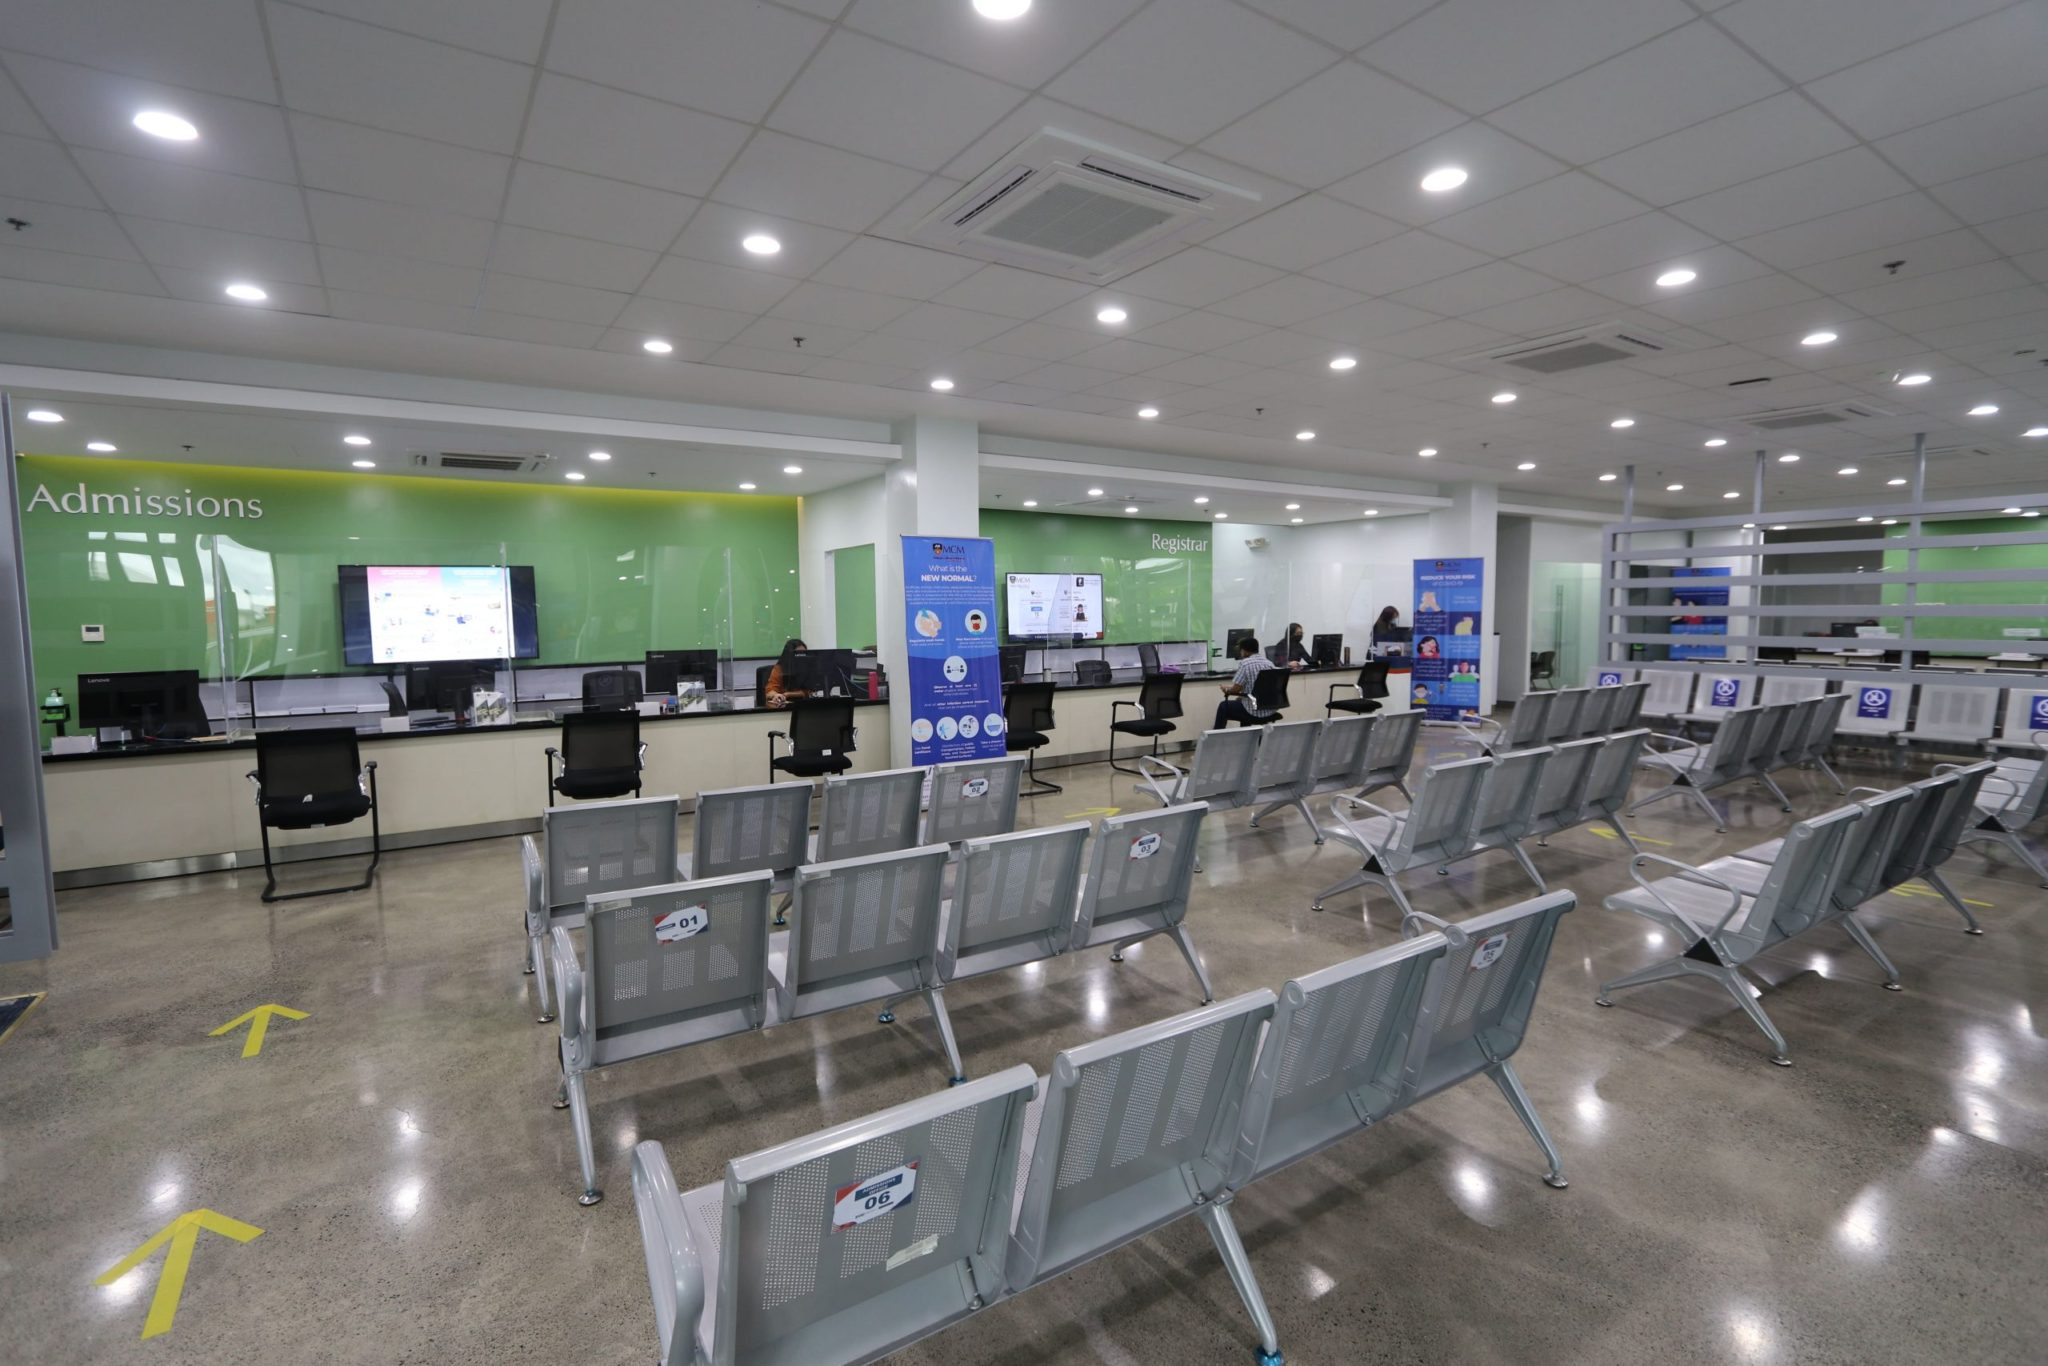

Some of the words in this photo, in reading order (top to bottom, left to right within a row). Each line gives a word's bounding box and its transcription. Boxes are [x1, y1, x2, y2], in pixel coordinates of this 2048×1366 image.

[26, 482, 264, 519] Admissions
[942, 545, 966, 555] MCM
[1151, 533, 1209, 555] Registrar
[928, 564, 948, 573] What
[955, 565, 968, 573] the
[920, 574, 940, 582] NEW
[941, 574, 977, 583] NORMAL?
[679, 914, 698, 929] 01
[864, 1190, 891, 1210] 06
